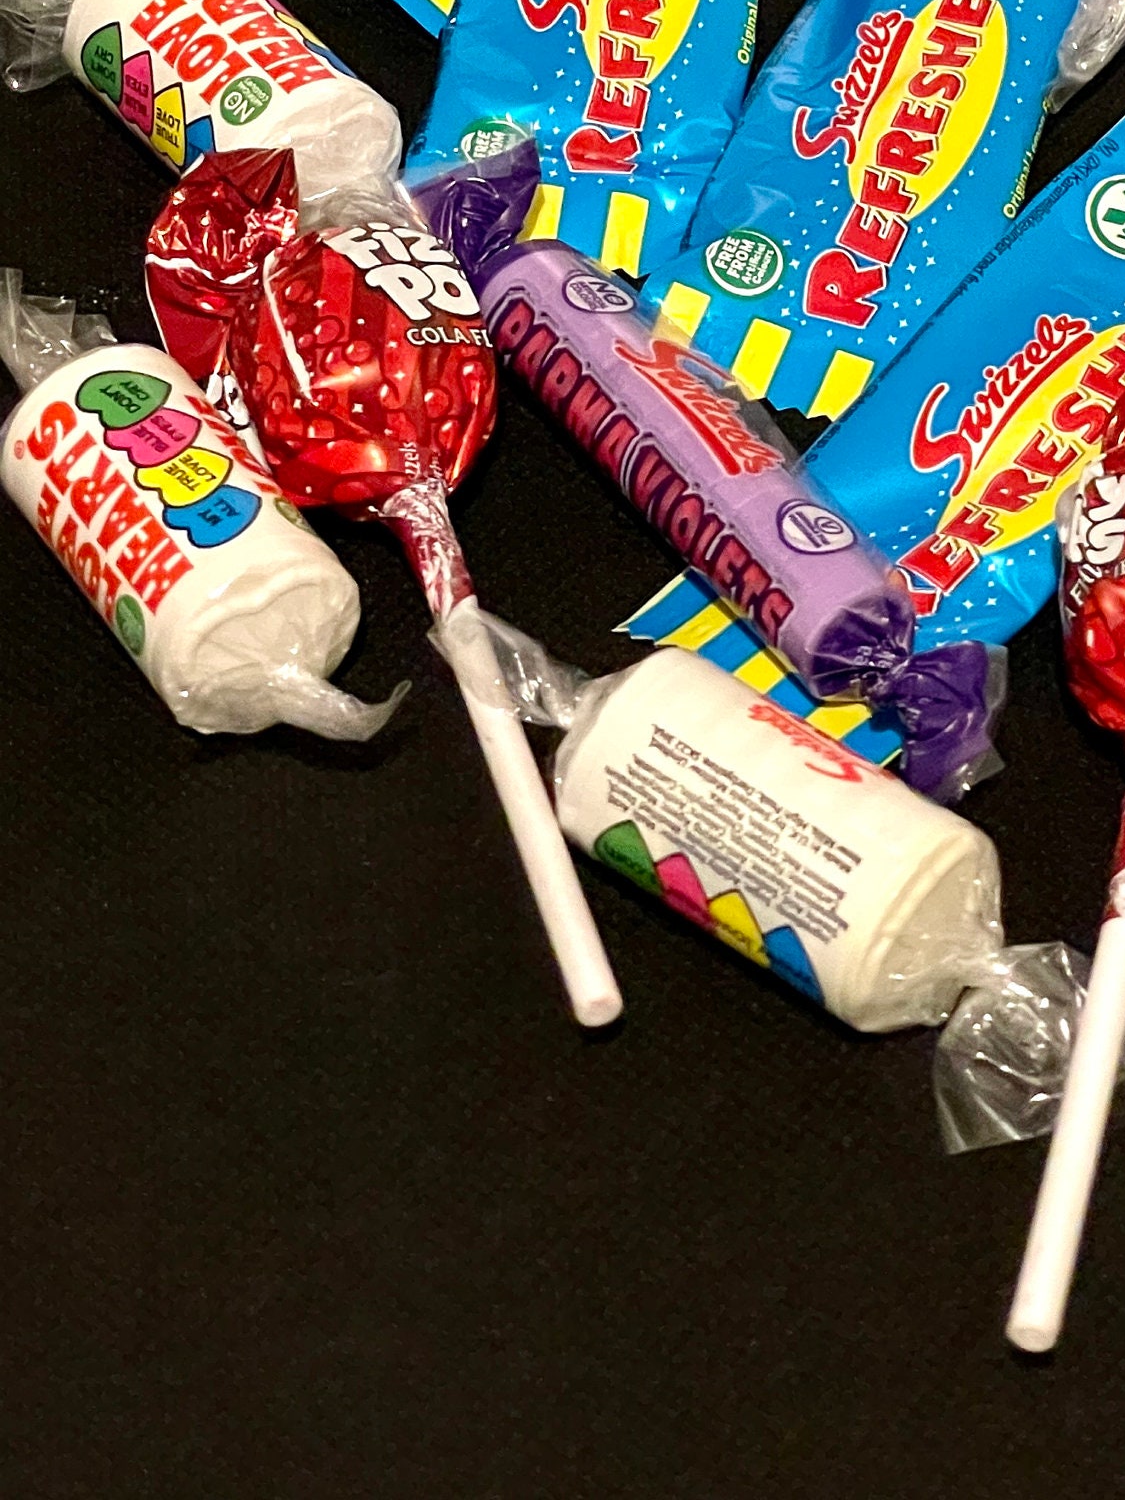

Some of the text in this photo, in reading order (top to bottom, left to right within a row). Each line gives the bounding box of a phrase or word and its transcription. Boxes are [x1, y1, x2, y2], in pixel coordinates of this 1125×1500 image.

[792, 10, 914, 165] Swizzels
[155, 106, 182, 130] LOVE
[224, 91, 256, 124] NO
[714, 235, 742, 270] FREE
[725, 239, 756, 280] FROM
[590, 276, 629, 309] NO
[406, 326, 471, 348] COLA
[613, 338, 785, 477] Swizzels
[910, 312, 1095, 495] Swizzels
[163, 461, 203, 492] TRUE
[178, 453, 218, 484] LOVE
[498, 296, 641, 482] PARMA
[628, 448, 796, 642] VIOLETS
[26, 399, 195, 617] HEARTS
